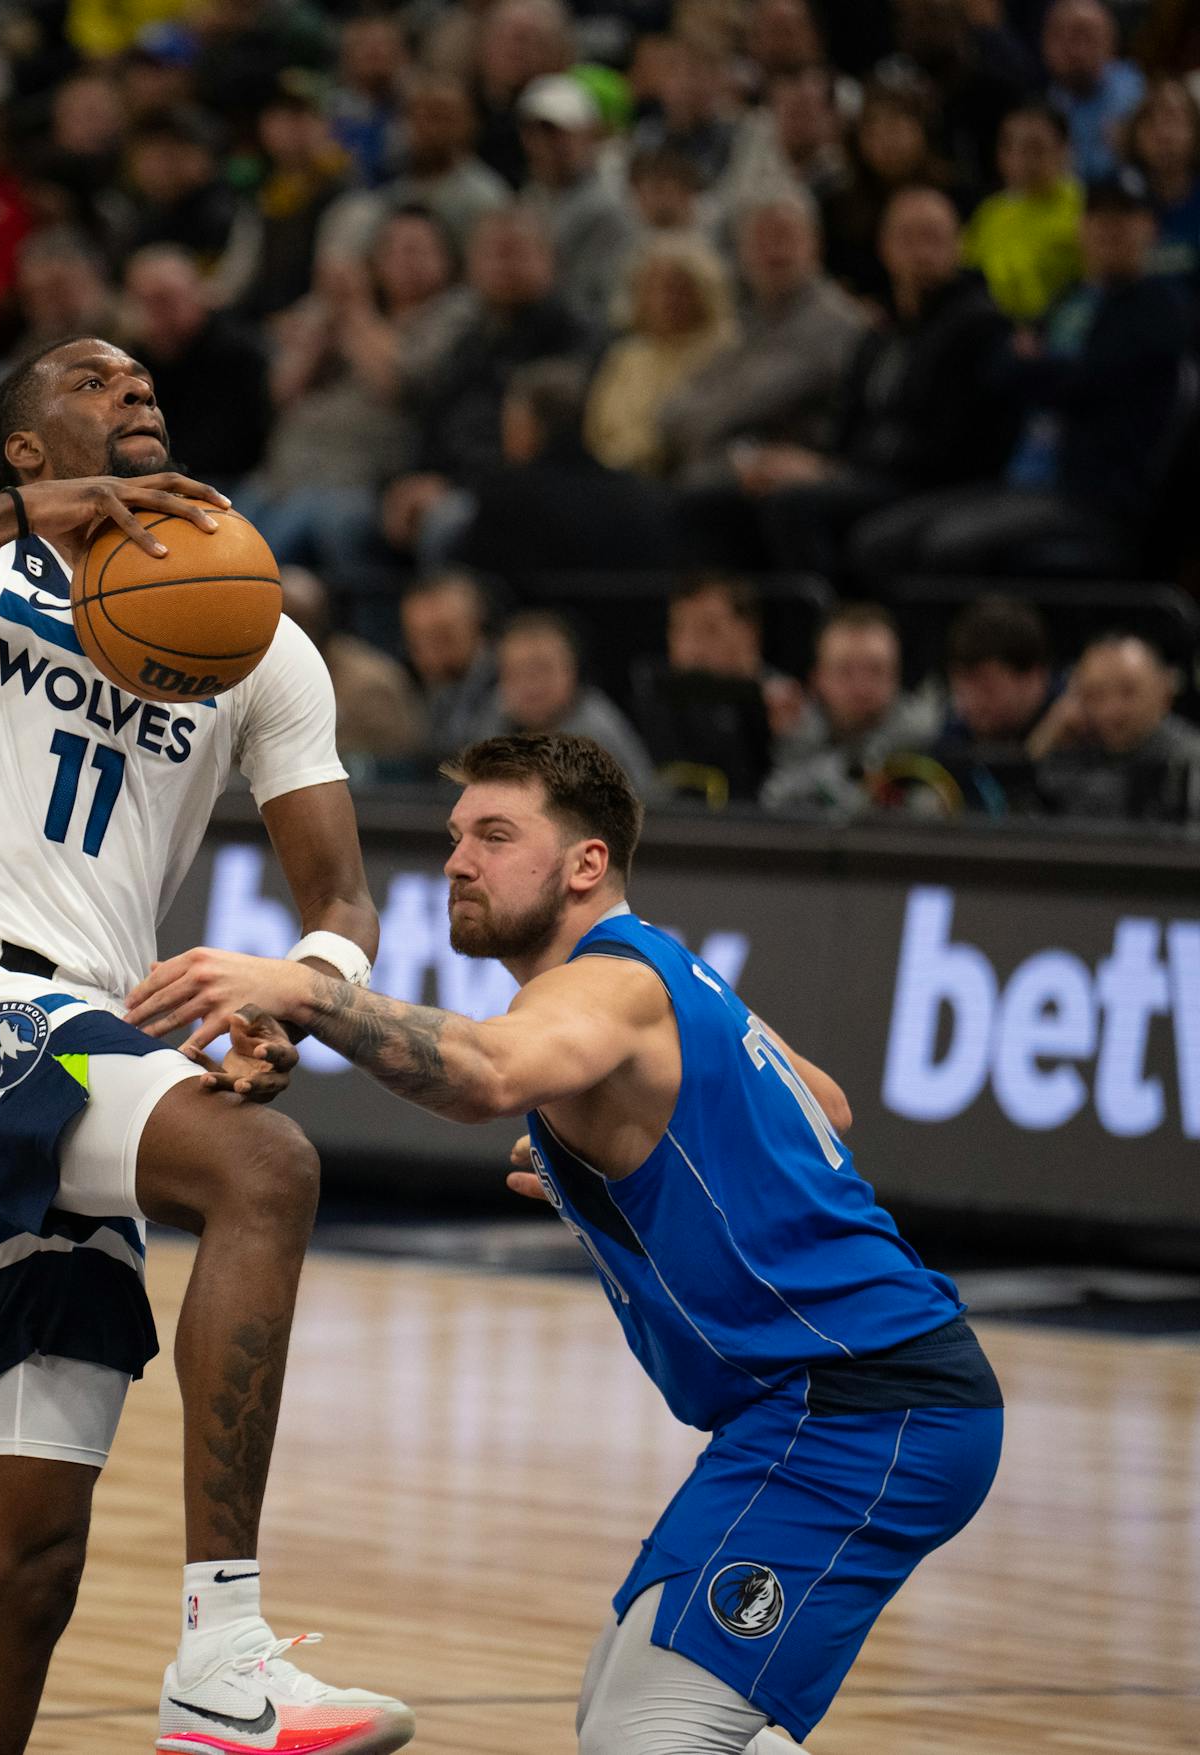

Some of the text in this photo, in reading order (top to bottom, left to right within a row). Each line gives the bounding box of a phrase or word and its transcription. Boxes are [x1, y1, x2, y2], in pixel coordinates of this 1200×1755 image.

[26, 554, 43, 577] 6
[0, 638, 196, 763] WOLVES
[44, 729, 126, 858] 11
